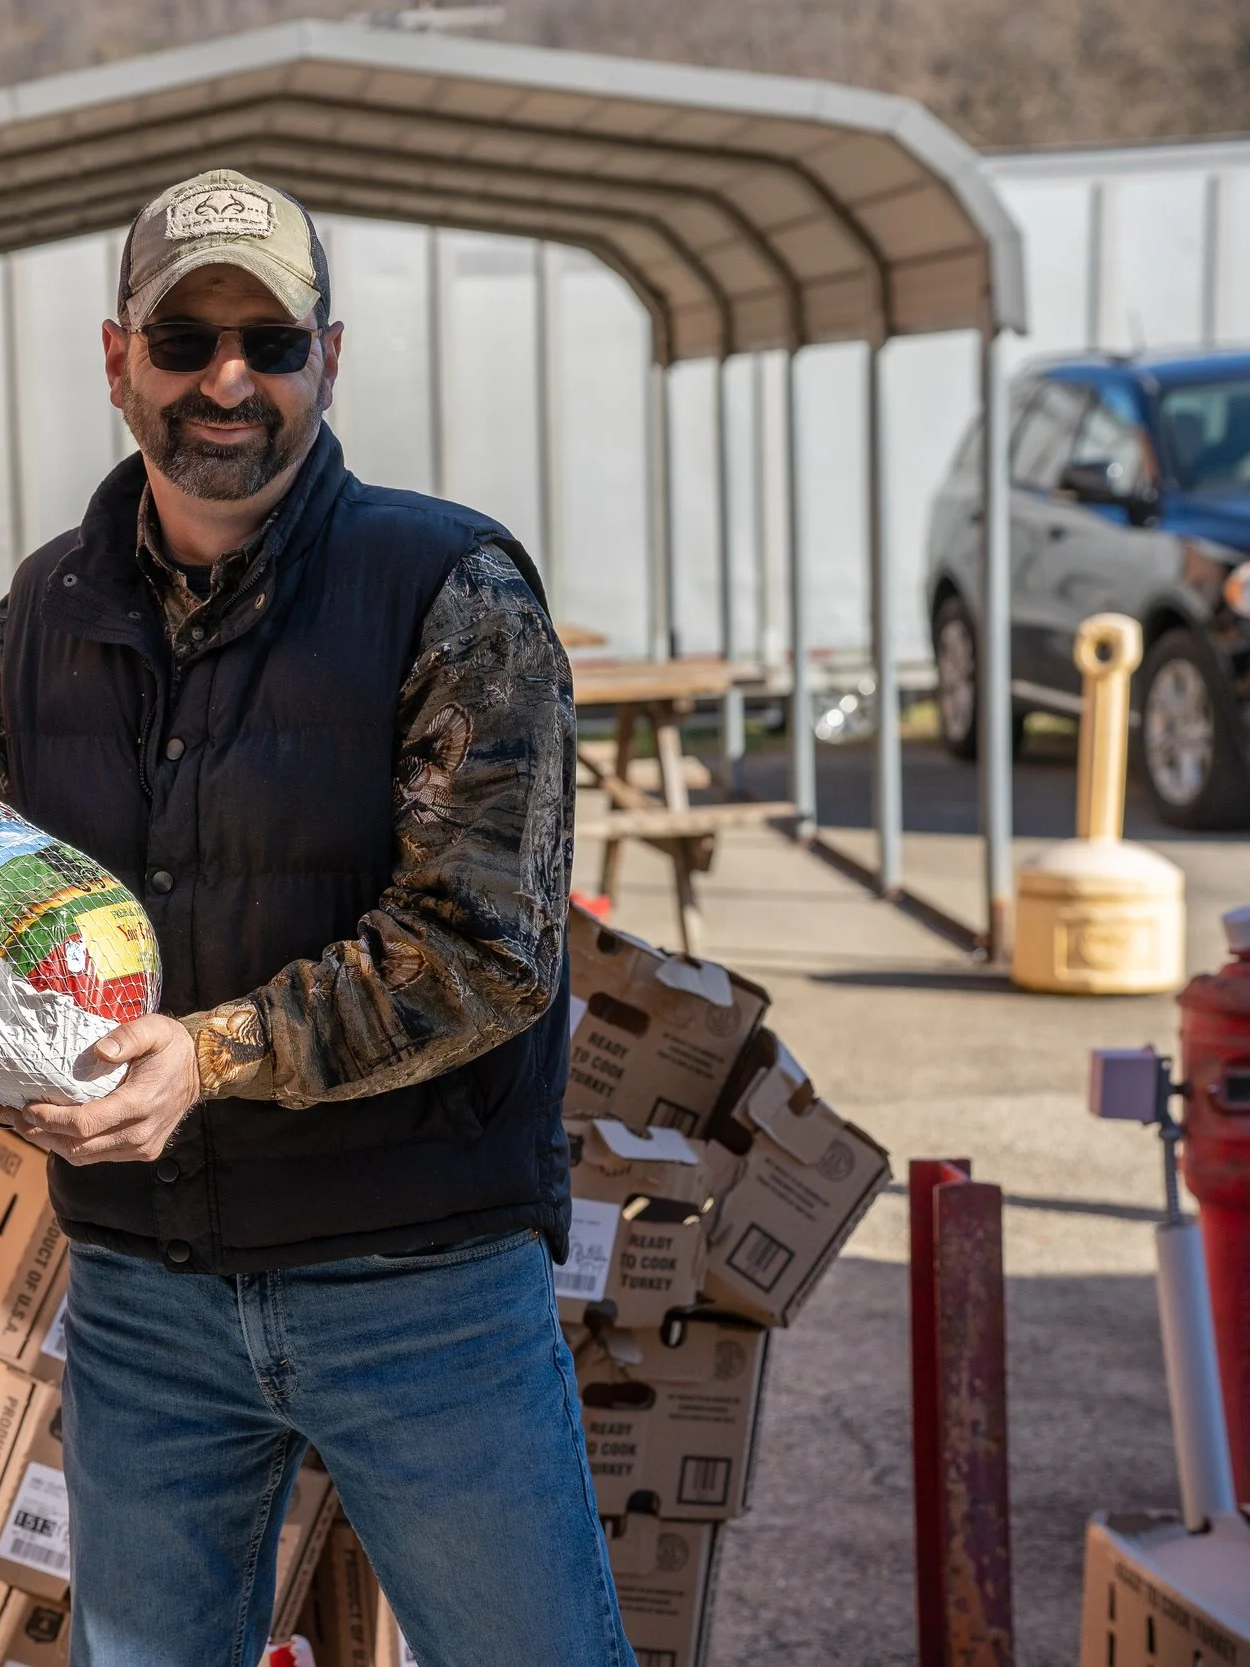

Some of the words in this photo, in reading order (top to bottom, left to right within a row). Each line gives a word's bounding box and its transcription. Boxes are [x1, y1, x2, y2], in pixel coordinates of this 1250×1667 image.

[34, 1218, 61, 1268] DUCT
[629, 1233, 674, 1251] READY
[620, 1252, 637, 1269] TO
[640, 1254, 678, 1271] COOK
[25, 1269, 43, 1293] OF
[621, 1272, 674, 1292] TURKEY
[590, 1462, 635, 1477] URKEY
